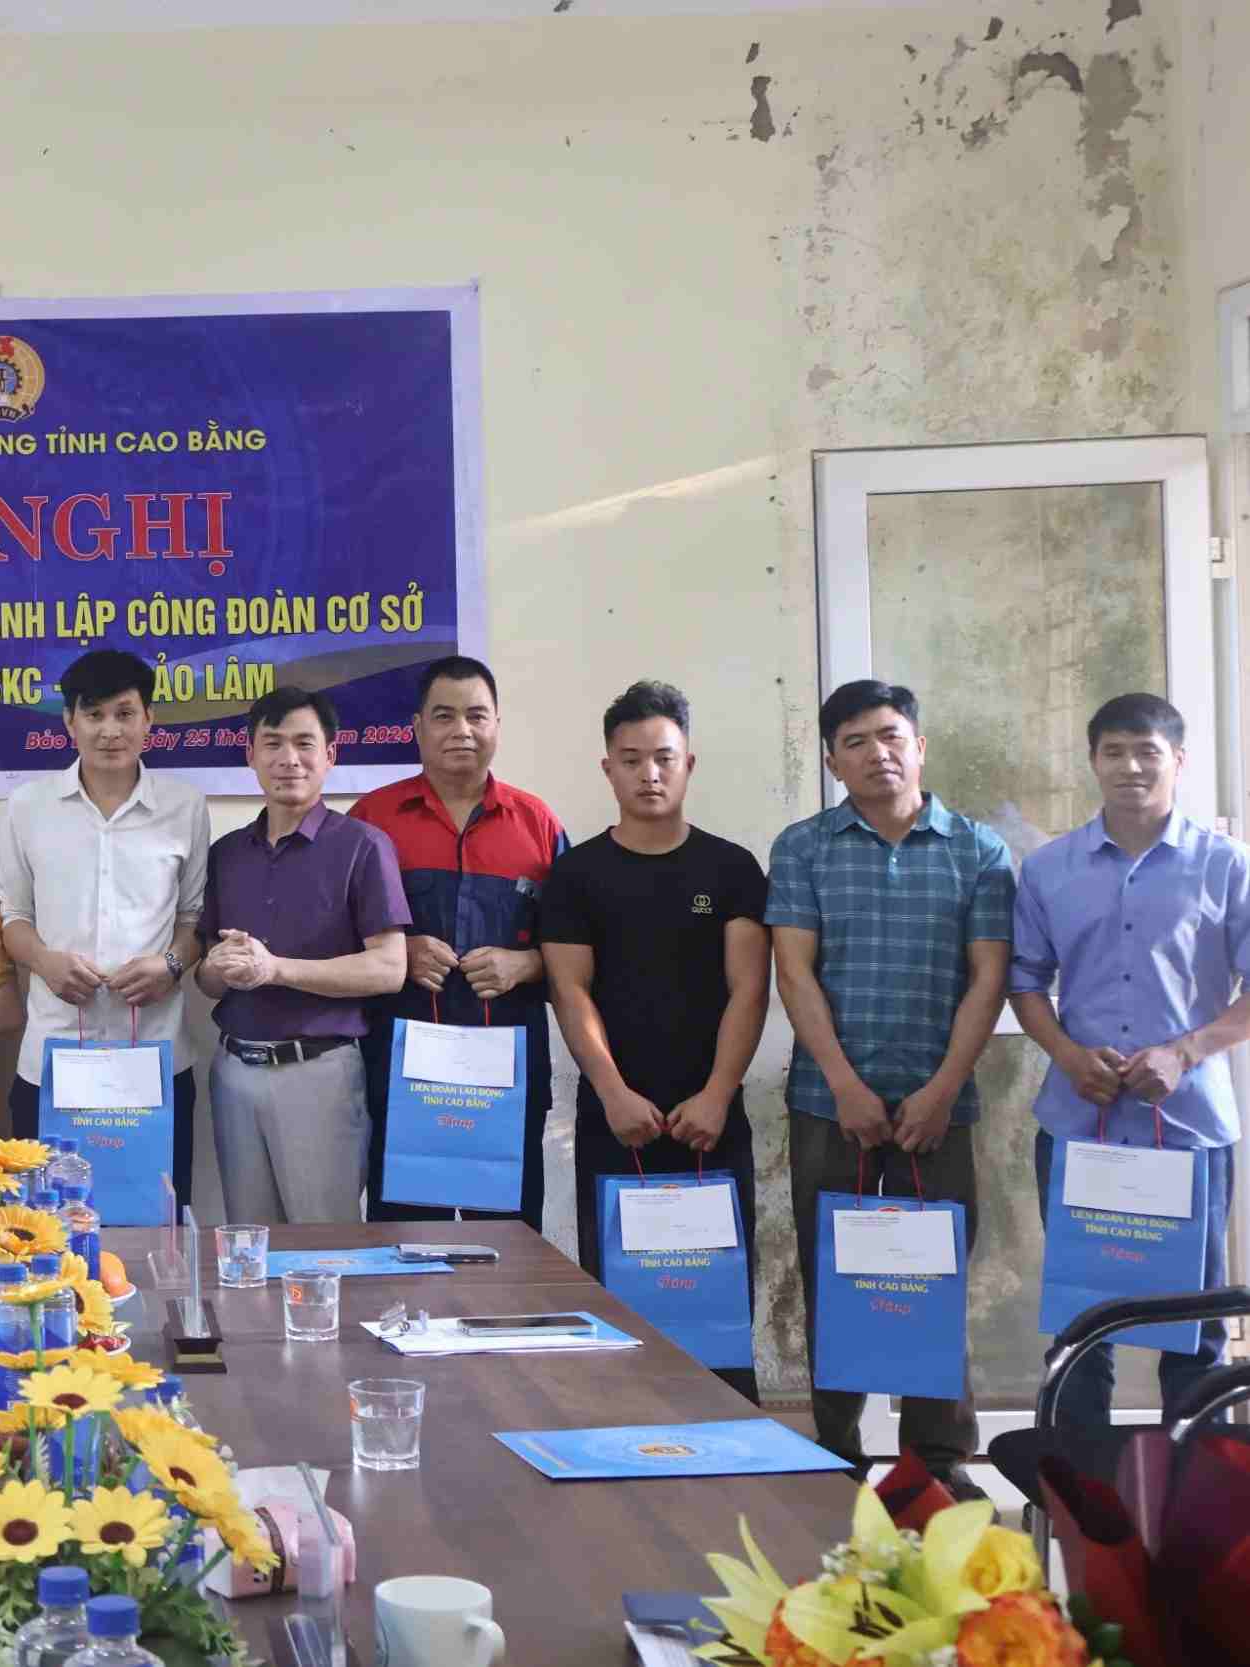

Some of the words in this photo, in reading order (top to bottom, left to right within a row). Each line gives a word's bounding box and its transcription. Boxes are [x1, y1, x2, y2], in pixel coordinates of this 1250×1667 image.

[46, 425, 107, 454] TỈNH
[115, 430, 179, 454] CAO
[188, 419, 267, 452] BẰNG
[56, 592, 116, 646] LẬP
[127, 591, 215, 637] CÔNG
[226, 588, 316, 635] ĐOÀN
[326, 591, 371, 633] CƠ
[381, 581, 425, 633] SỞ
[152, 652, 195, 702] ẢO
[205, 655, 274, 701] LÂM
[26, 729, 67, 750] Bảo
[183, 728, 211, 747] 25
[361, 725, 414, 744] 2026
